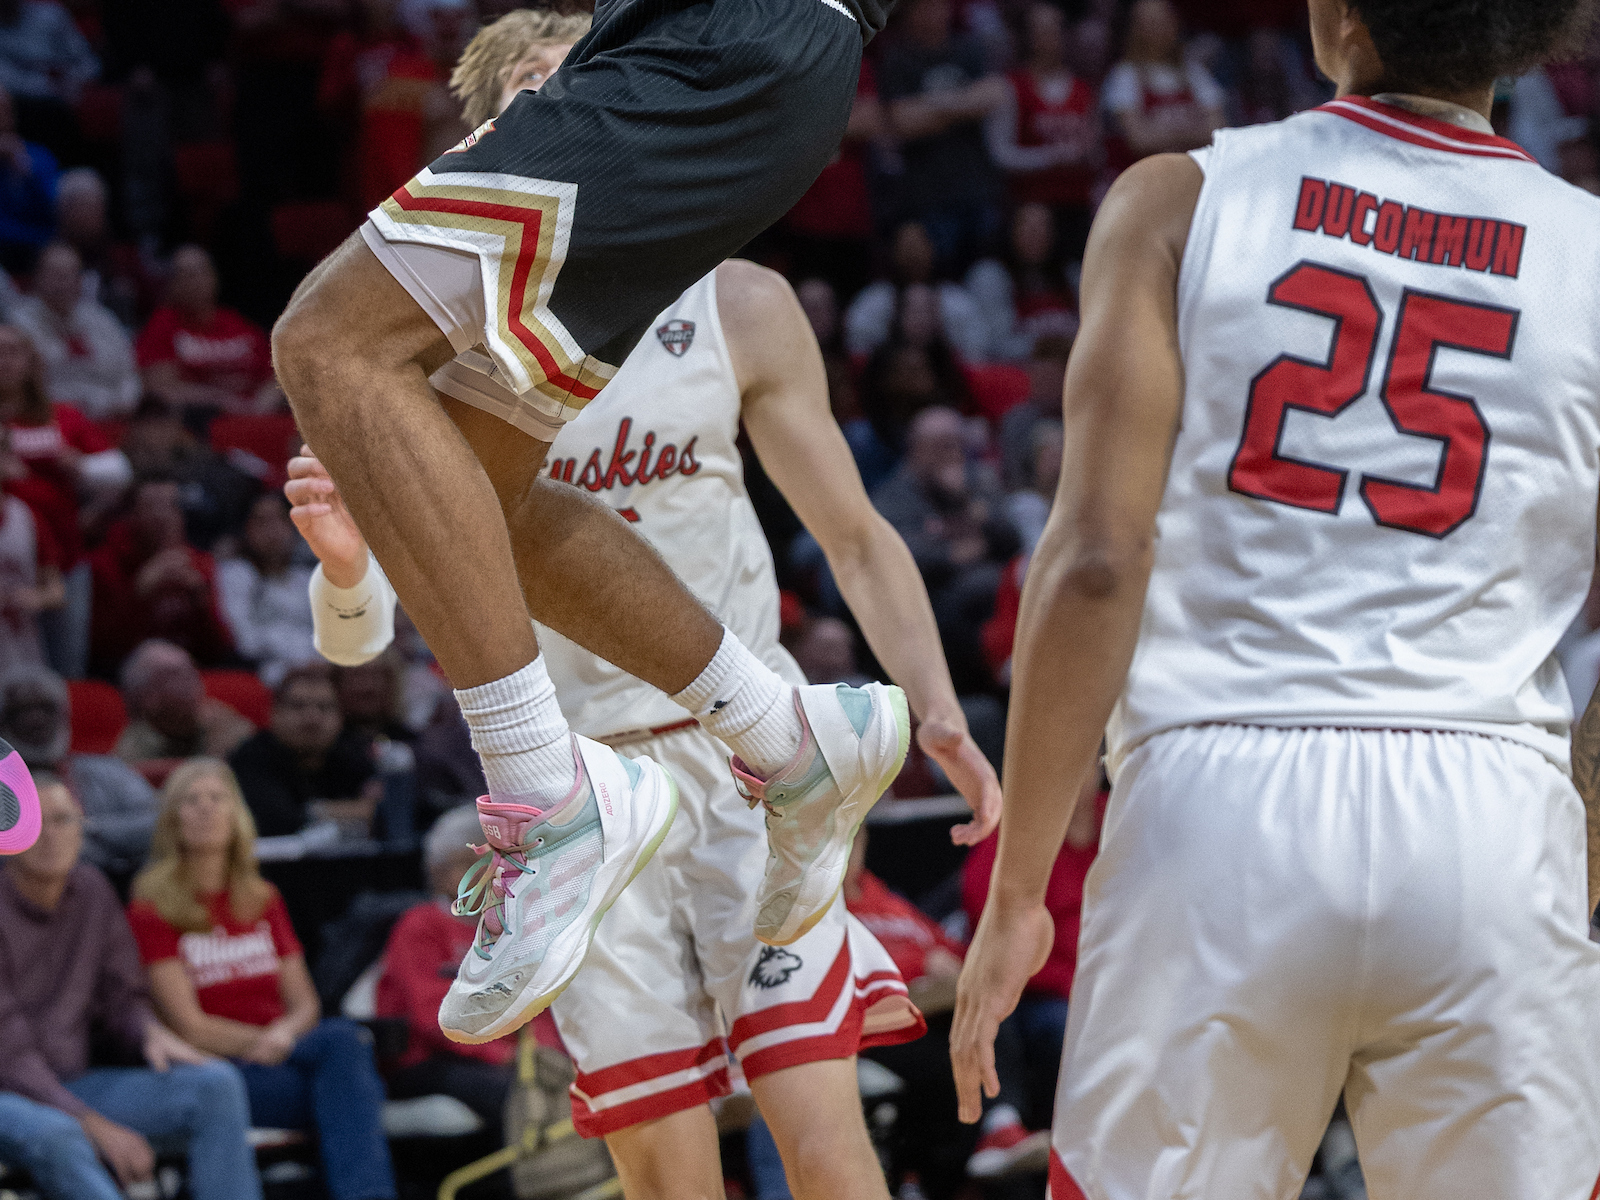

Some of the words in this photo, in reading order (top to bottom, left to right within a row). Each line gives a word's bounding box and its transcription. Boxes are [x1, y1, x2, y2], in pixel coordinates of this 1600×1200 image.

[1293, 175, 1527, 279] DUCOMMUN
[1227, 258, 1521, 540] 25
[549, 416, 702, 492] uskies
[599, 782, 614, 816] ADIZERO
